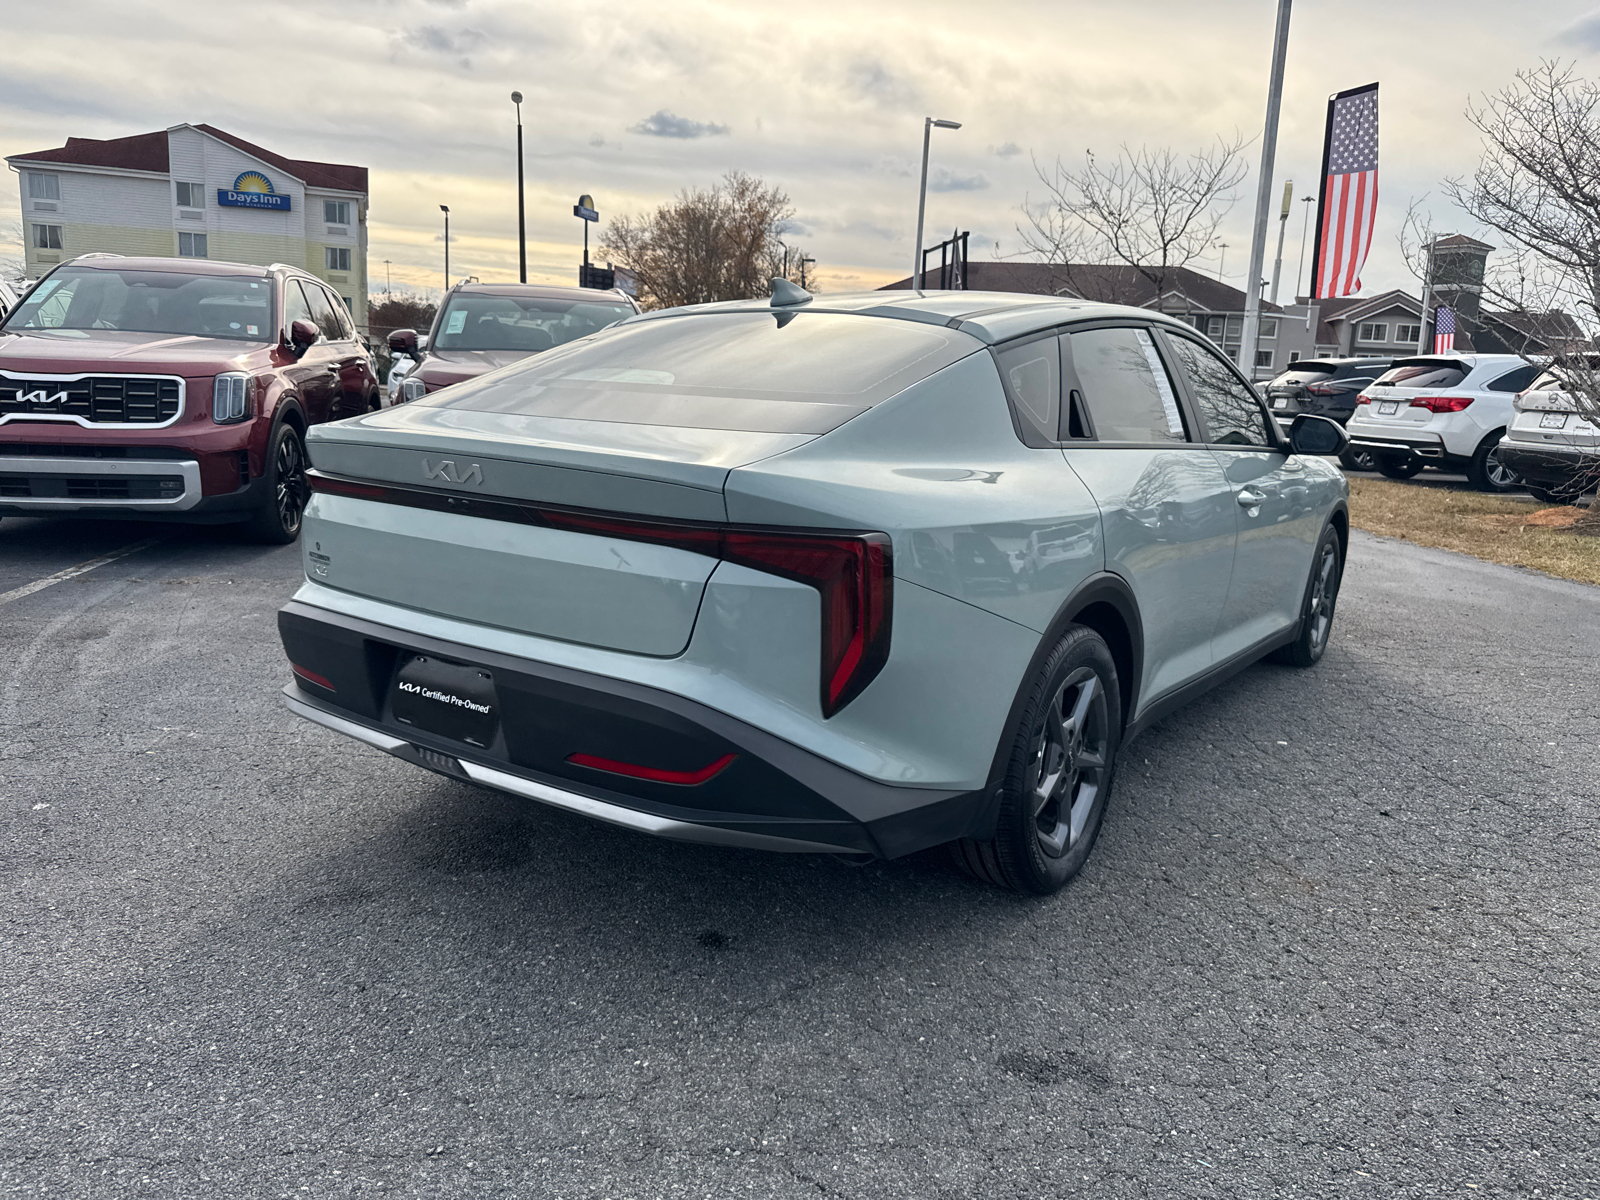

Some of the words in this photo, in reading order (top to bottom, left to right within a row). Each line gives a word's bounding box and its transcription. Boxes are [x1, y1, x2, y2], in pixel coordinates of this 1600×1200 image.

[228, 191, 259, 203] Days
[260, 194, 281, 205] Inn
[16, 389, 68, 403] KIA
[420, 459, 483, 486] KIA
[399, 681, 421, 694] KIA
[421, 687, 450, 703] Certified
[450, 695, 489, 714] Pre-Owned
